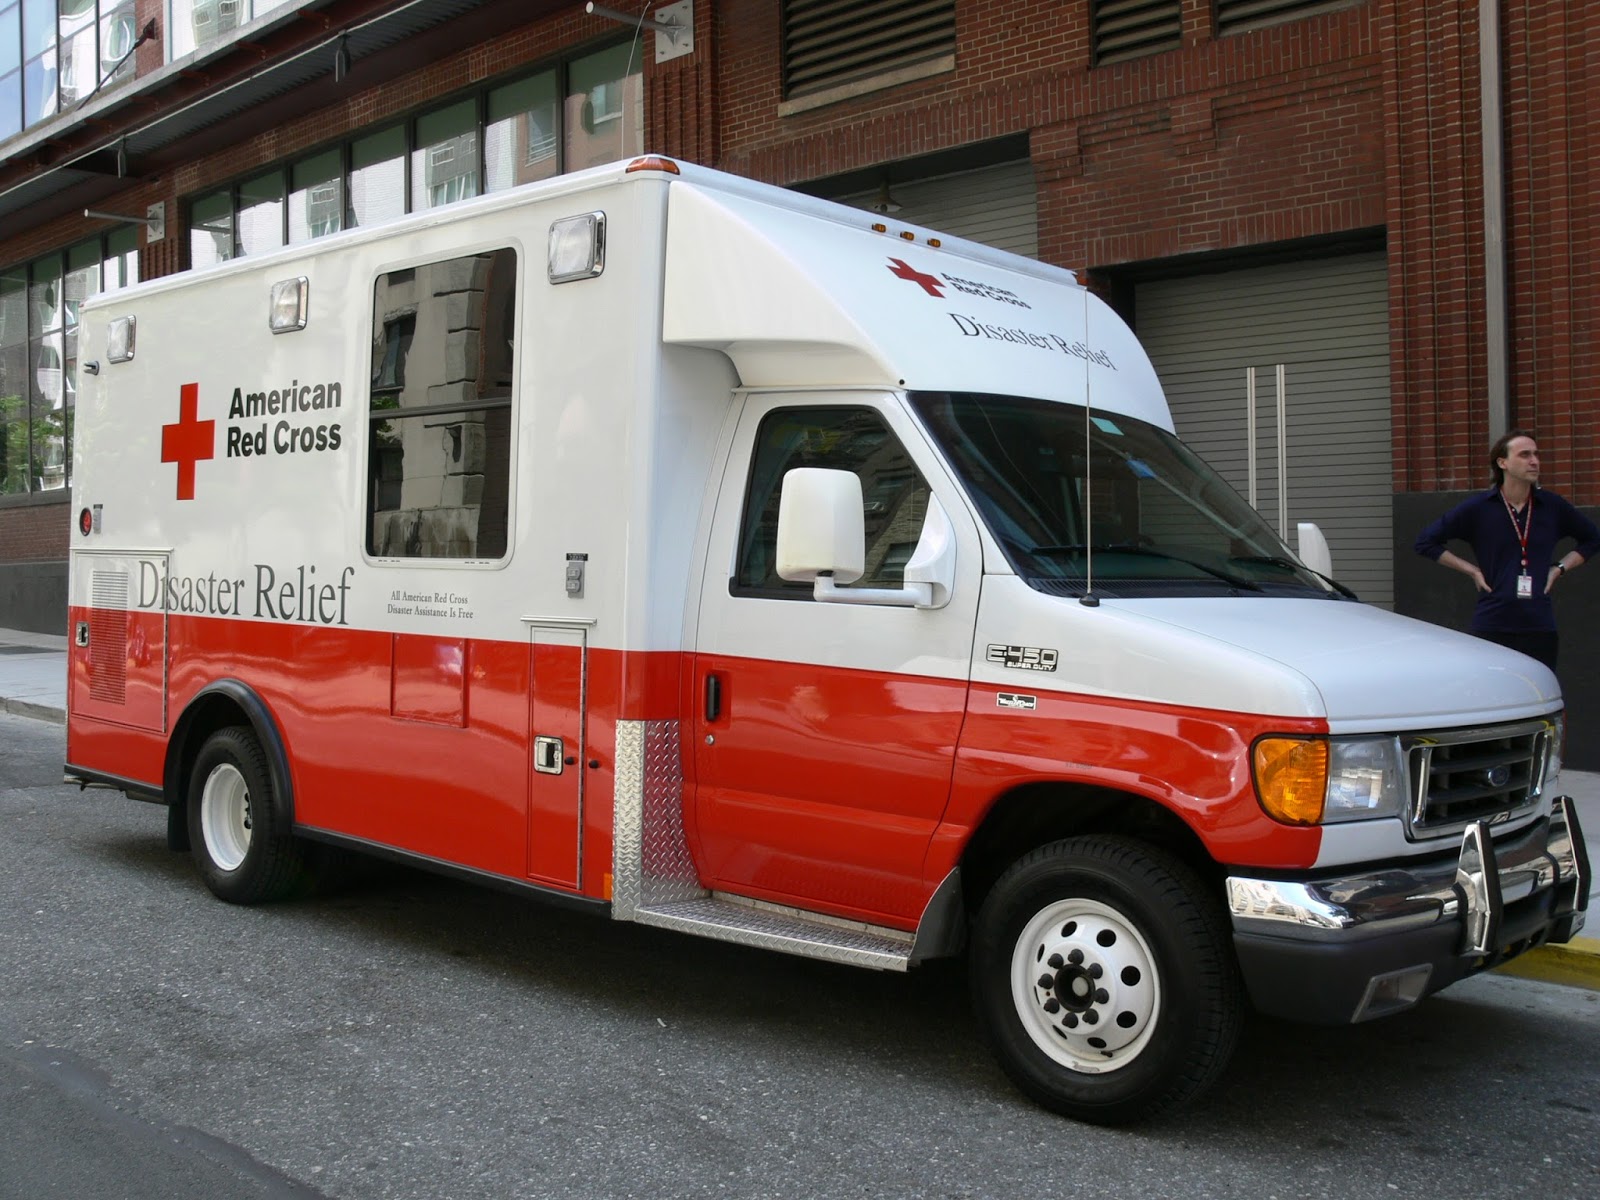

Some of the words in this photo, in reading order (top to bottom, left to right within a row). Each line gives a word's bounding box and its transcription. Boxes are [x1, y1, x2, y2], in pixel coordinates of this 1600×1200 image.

[940, 272, 1019, 299] American
[950, 281, 987, 298] Red
[984, 290, 1032, 310] Cross
[946, 312, 1056, 351] Disaster
[1047, 333, 1119, 371] Relief
[228, 379, 342, 420] American
[227, 422, 268, 458] Red
[273, 420, 342, 455] Cross
[137, 560, 245, 616] Disaster
[253, 564, 355, 625] Relief
[391, 590, 401, 601] All
[402, 591, 432, 602] American
[434, 592, 448, 604] Red
[449, 593, 468, 604] Cross
[387, 603, 413, 615] Disaster
[414, 605, 447, 617] Assistance
[449, 607, 457, 618] Is
[458, 607, 473, 618] Free
[1006, 661, 1032, 669] SUPER
